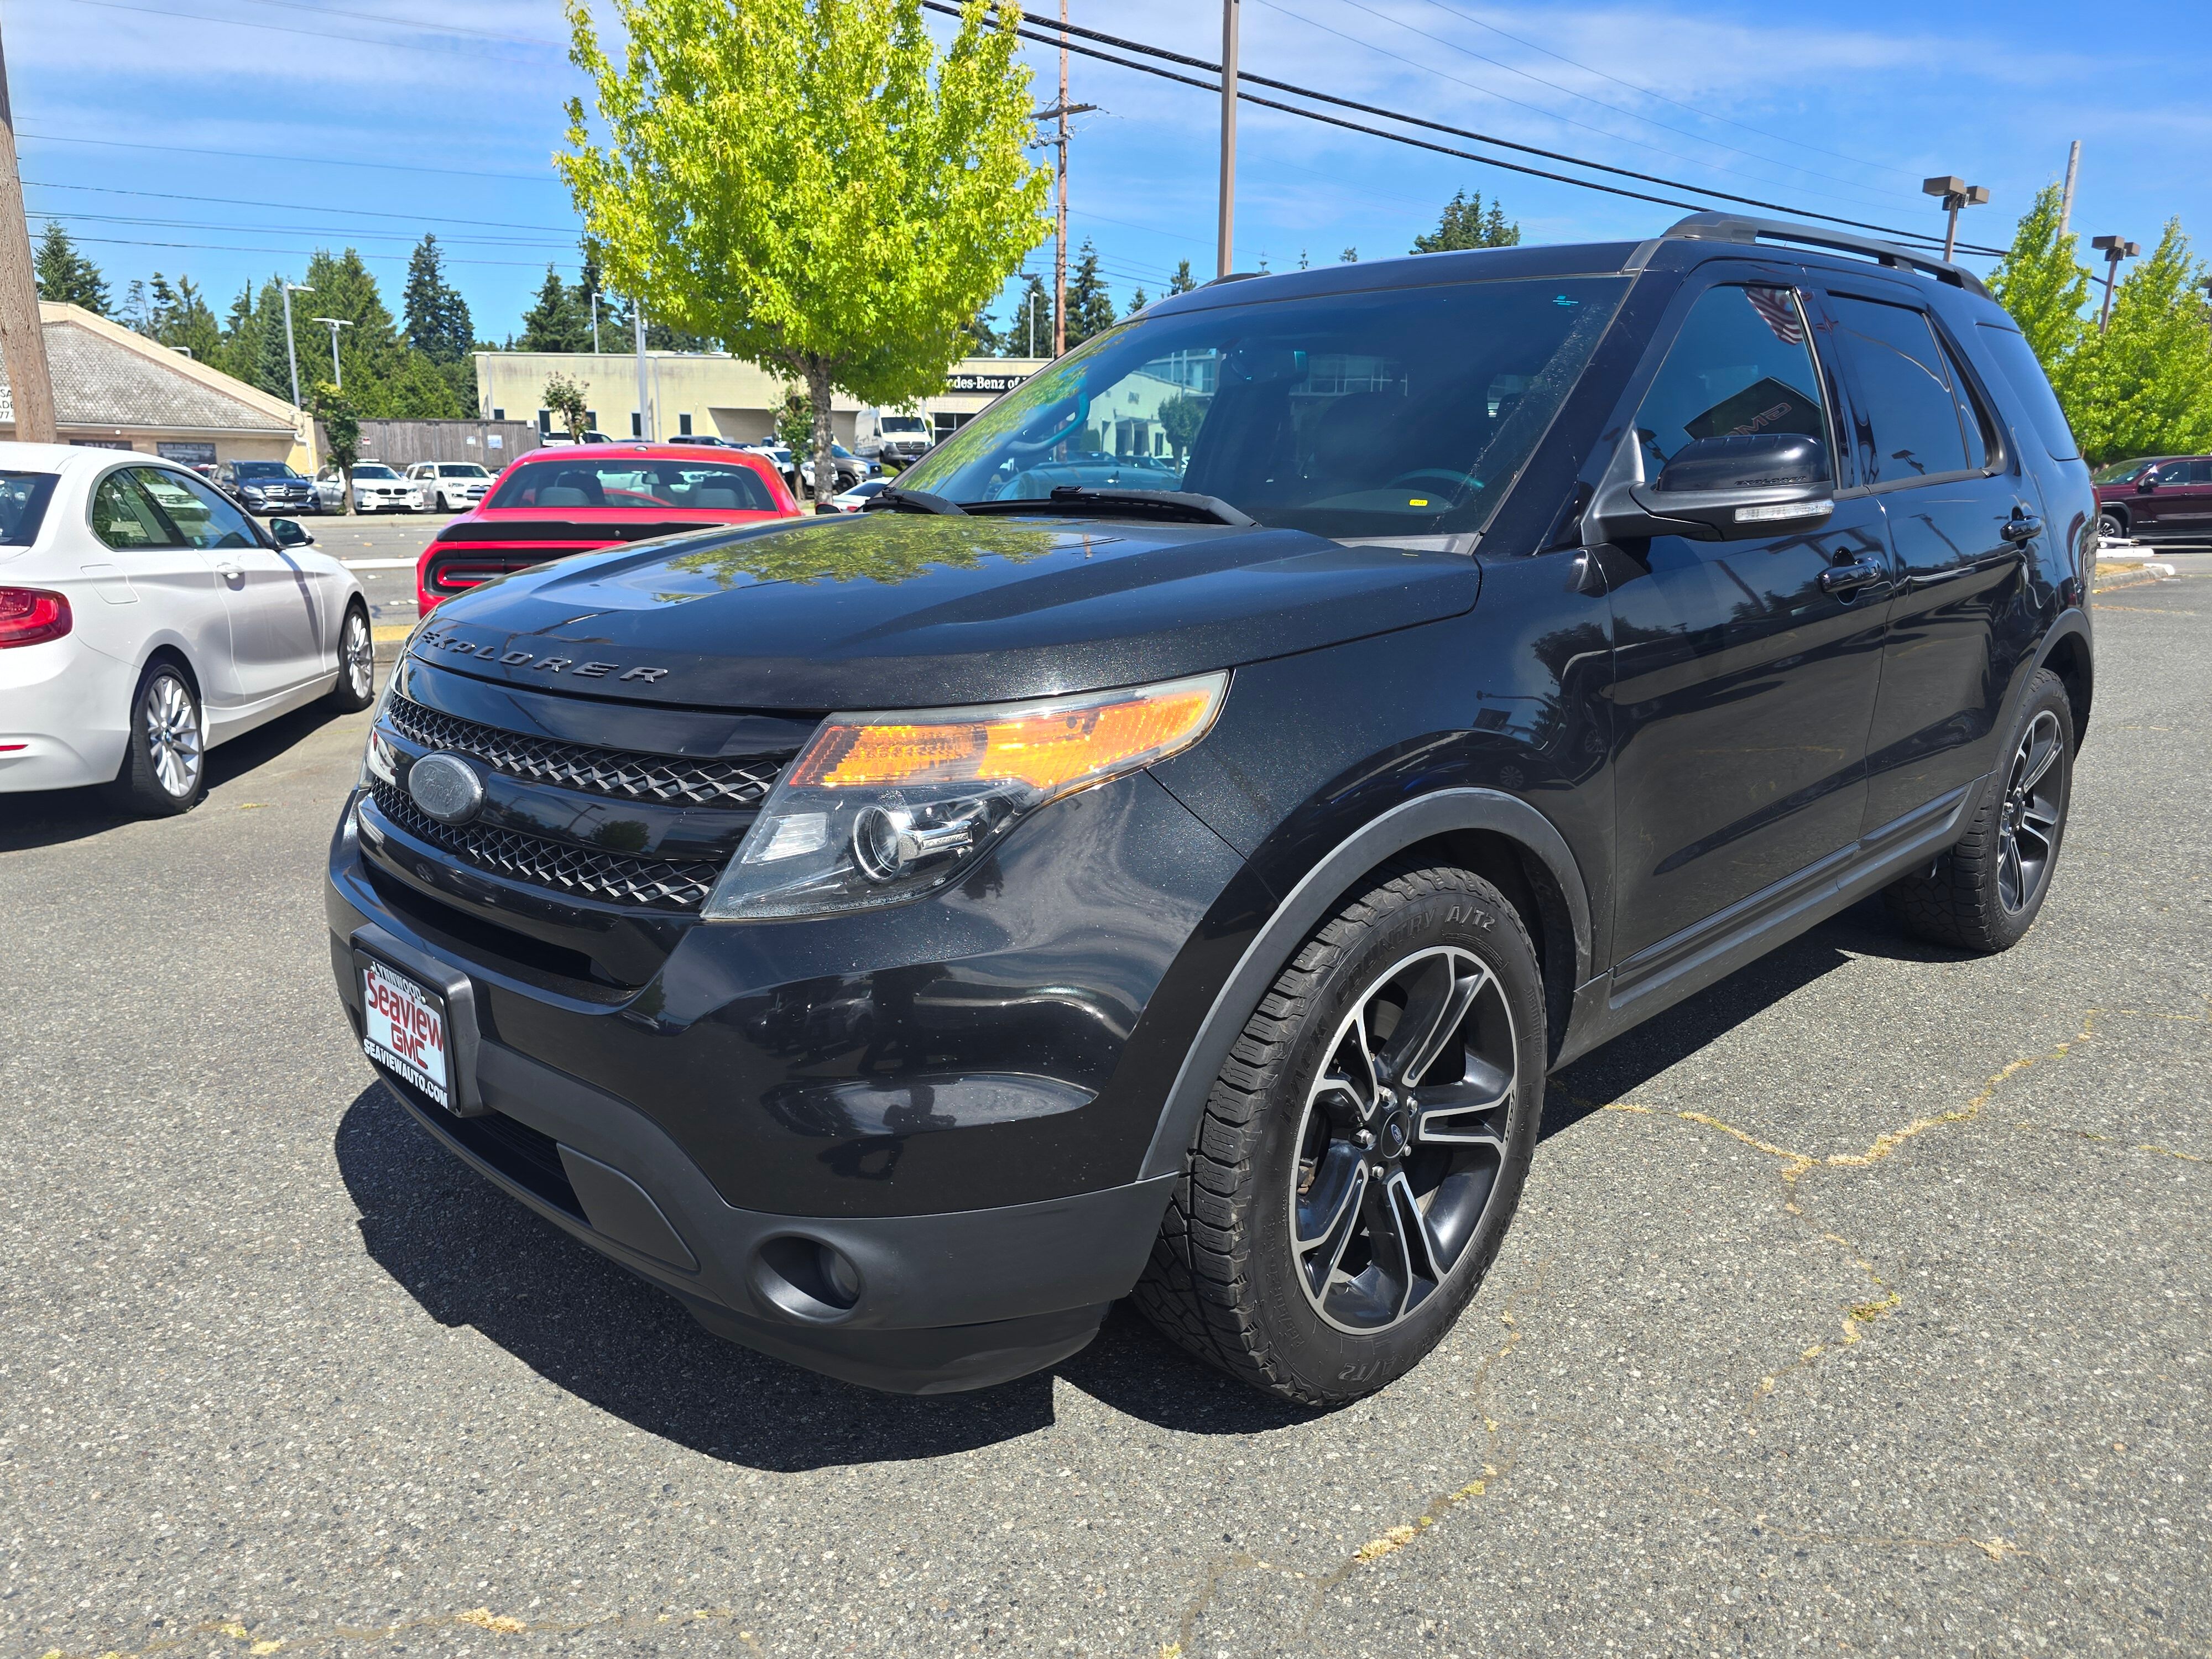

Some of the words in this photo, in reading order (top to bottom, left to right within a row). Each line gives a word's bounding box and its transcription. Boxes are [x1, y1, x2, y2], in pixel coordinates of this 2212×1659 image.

[1734, 477, 1806, 486] EXPLORER
[420, 631, 667, 682] EXPLORER
[1444, 904, 1495, 931] A/T2
[367, 971, 442, 1052] Seaview
[391, 1022, 428, 1070] GMC
[363, 1038, 448, 1109] SEAVIEWAUTO.COM
